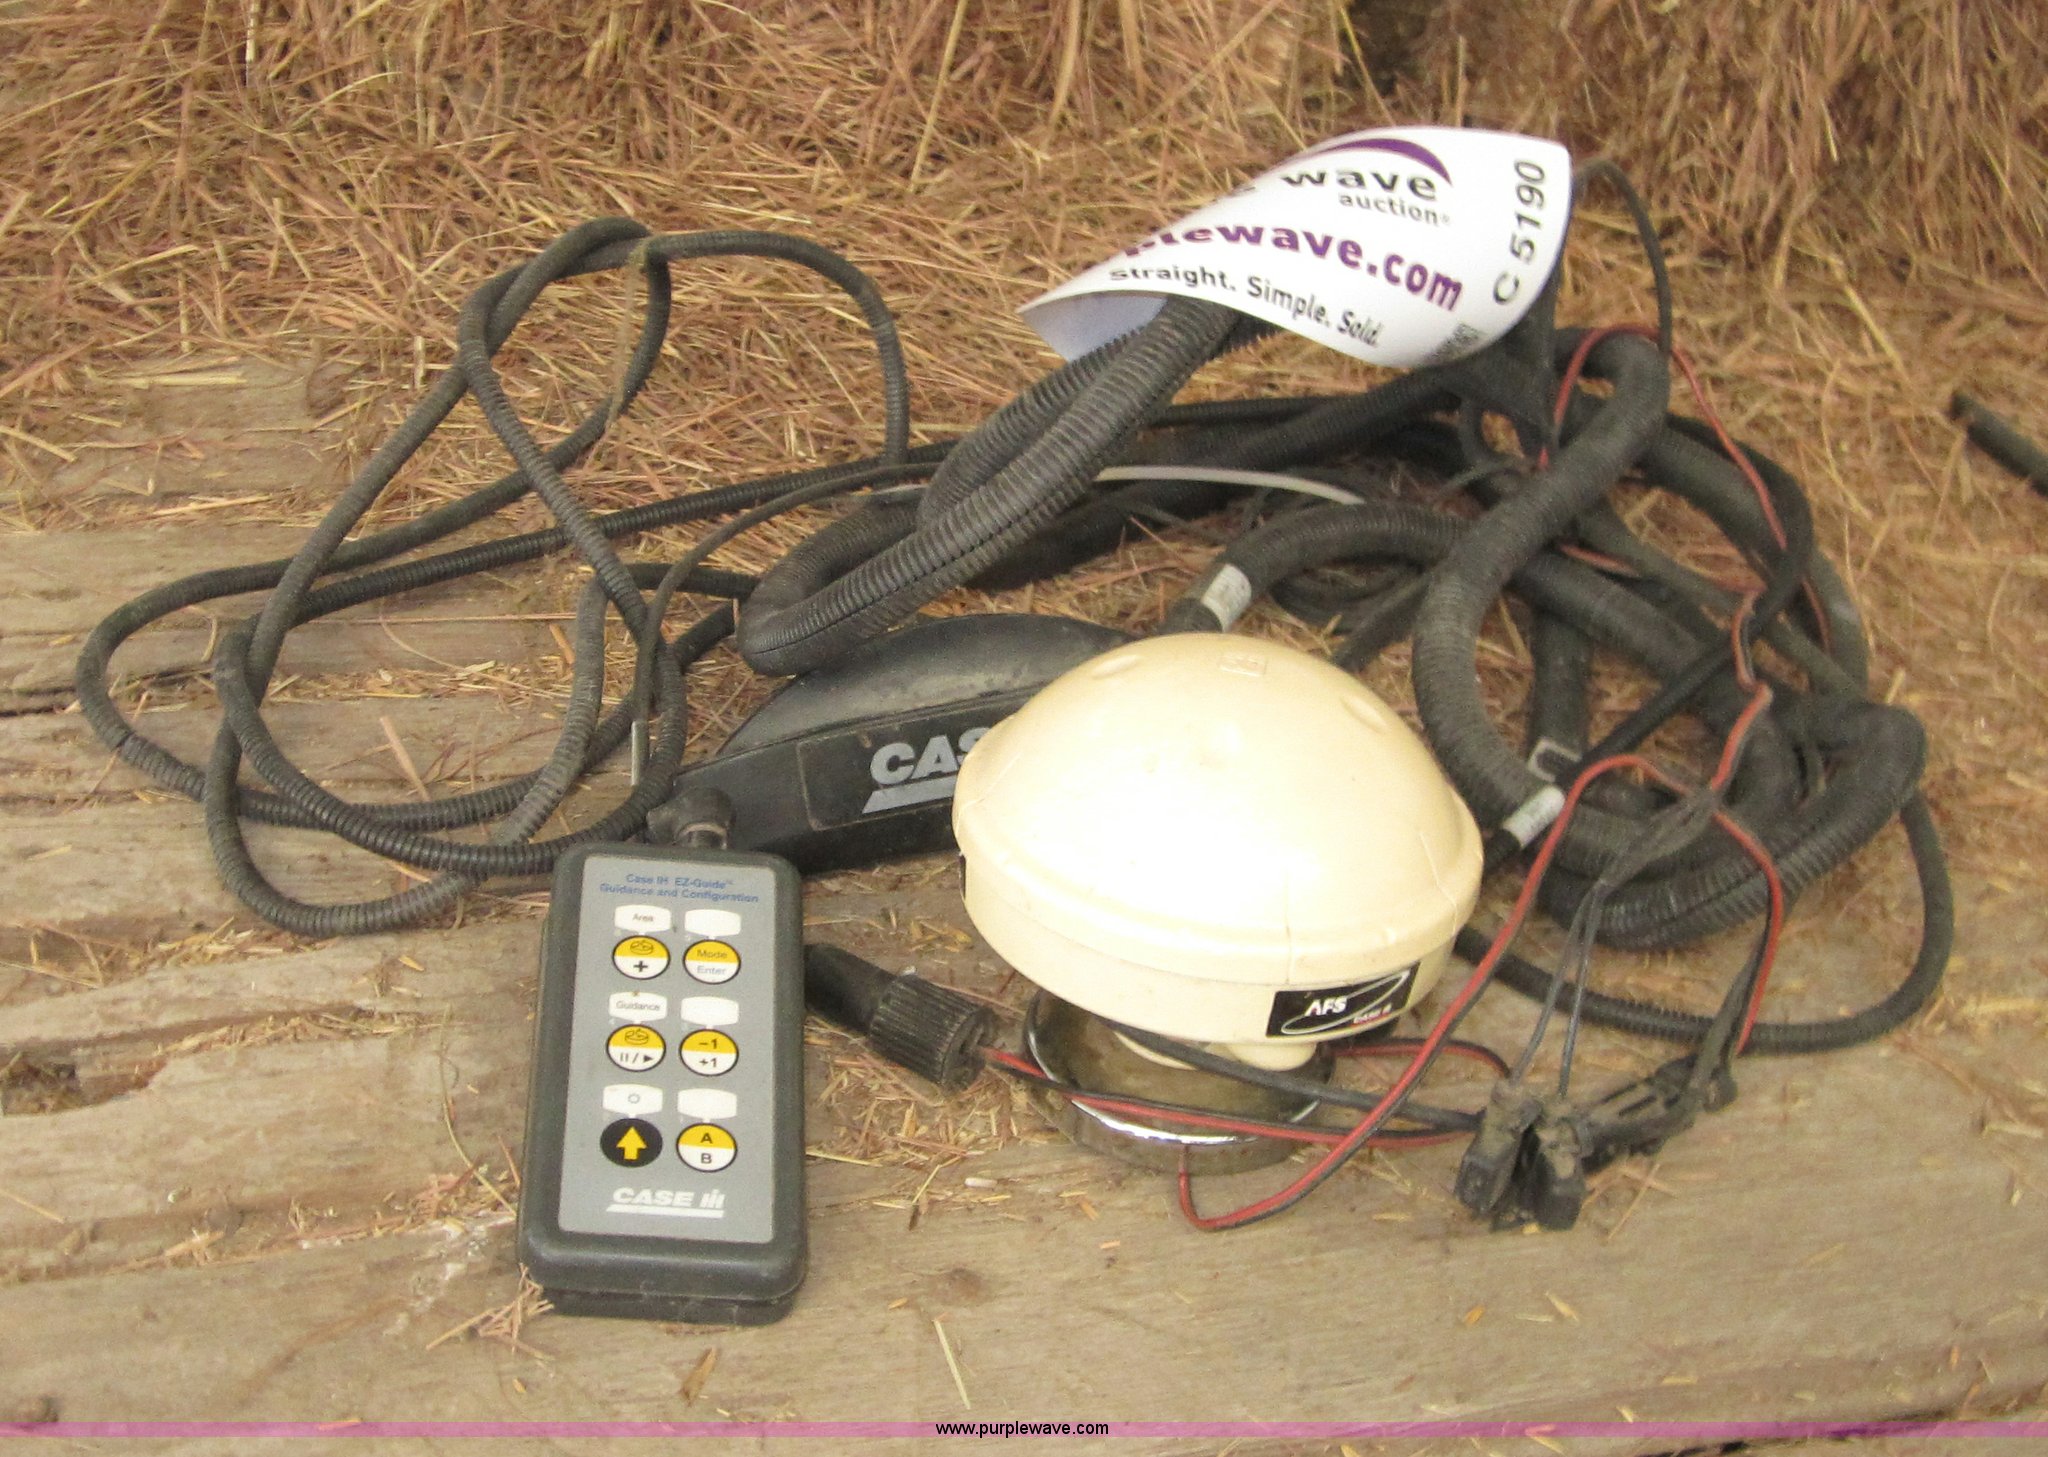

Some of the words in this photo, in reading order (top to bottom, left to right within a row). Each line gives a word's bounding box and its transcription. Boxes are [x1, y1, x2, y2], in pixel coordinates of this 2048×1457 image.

[1280, 168, 1438, 201] wave
[1492, 269, 1520, 306] C
[1508, 157, 1547, 266] 5190
[1246, 274, 1331, 328] Simple.
[869, 726, 990, 786] CAS
[626, 873, 653, 885] Case
[600, 883, 653, 896] Guidance
[657, 889, 678, 898] and
[681, 889, 760, 903] Configuration
[632, 913, 654, 923] Area
[696, 949, 728, 960] Mode
[696, 964, 727, 976] Enter
[615, 999, 661, 1012] Guidance
[1305, 996, 1348, 1017] AFS
[700, 1132, 714, 1145] A
[700, 1153, 713, 1164] B
[612, 1187, 695, 1207] CASE
